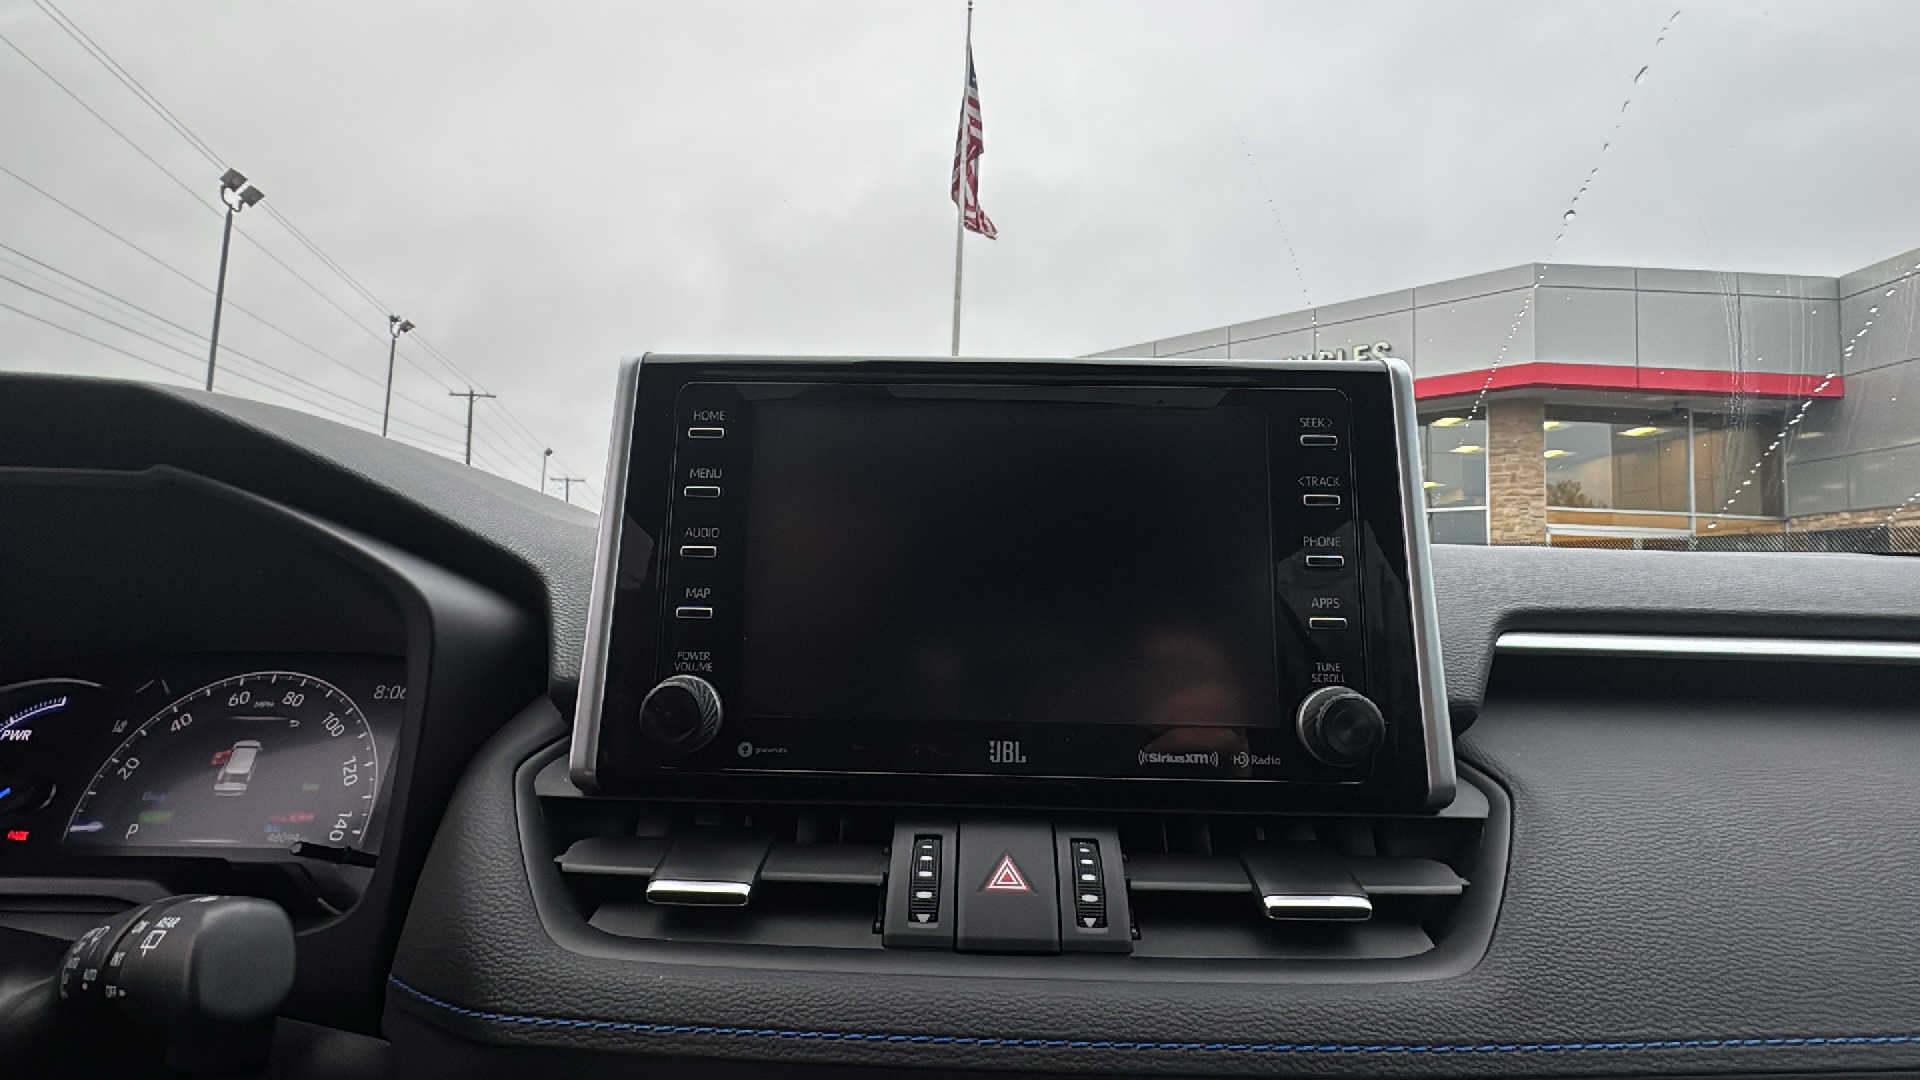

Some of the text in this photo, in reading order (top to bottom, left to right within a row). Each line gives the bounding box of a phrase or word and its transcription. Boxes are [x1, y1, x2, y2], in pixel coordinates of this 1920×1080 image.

[693, 410, 726, 421] HOME
[1300, 417, 1325, 428] SEEK
[689, 468, 722, 479] MENU
[1304, 476, 1341, 487] TRACK
[684, 527, 720, 538] AUDIO
[1303, 536, 1341, 547] PHONE
[685, 587, 711, 599] MAP
[1311, 597, 1341, 609] APPS
[677, 652, 711, 662] POWER
[674, 662, 713, 672] VOLUME
[1316, 662, 1341, 672] TUNE
[1311, 673, 1345, 683] SCROLL
[228, 690, 251, 707] 60
[281, 691, 305, 707] 80
[170, 713, 193, 733] 40
[321, 711, 346, 738] 100
[0, 729, 33, 741] PWR
[989, 740, 1027, 763] JBL
[1251, 754, 1281, 765] Radio
[117, 757, 141, 780] 20
[342, 755, 358, 787] 120
[125, 823, 139, 840] P
[329, 810, 353, 842] 140
